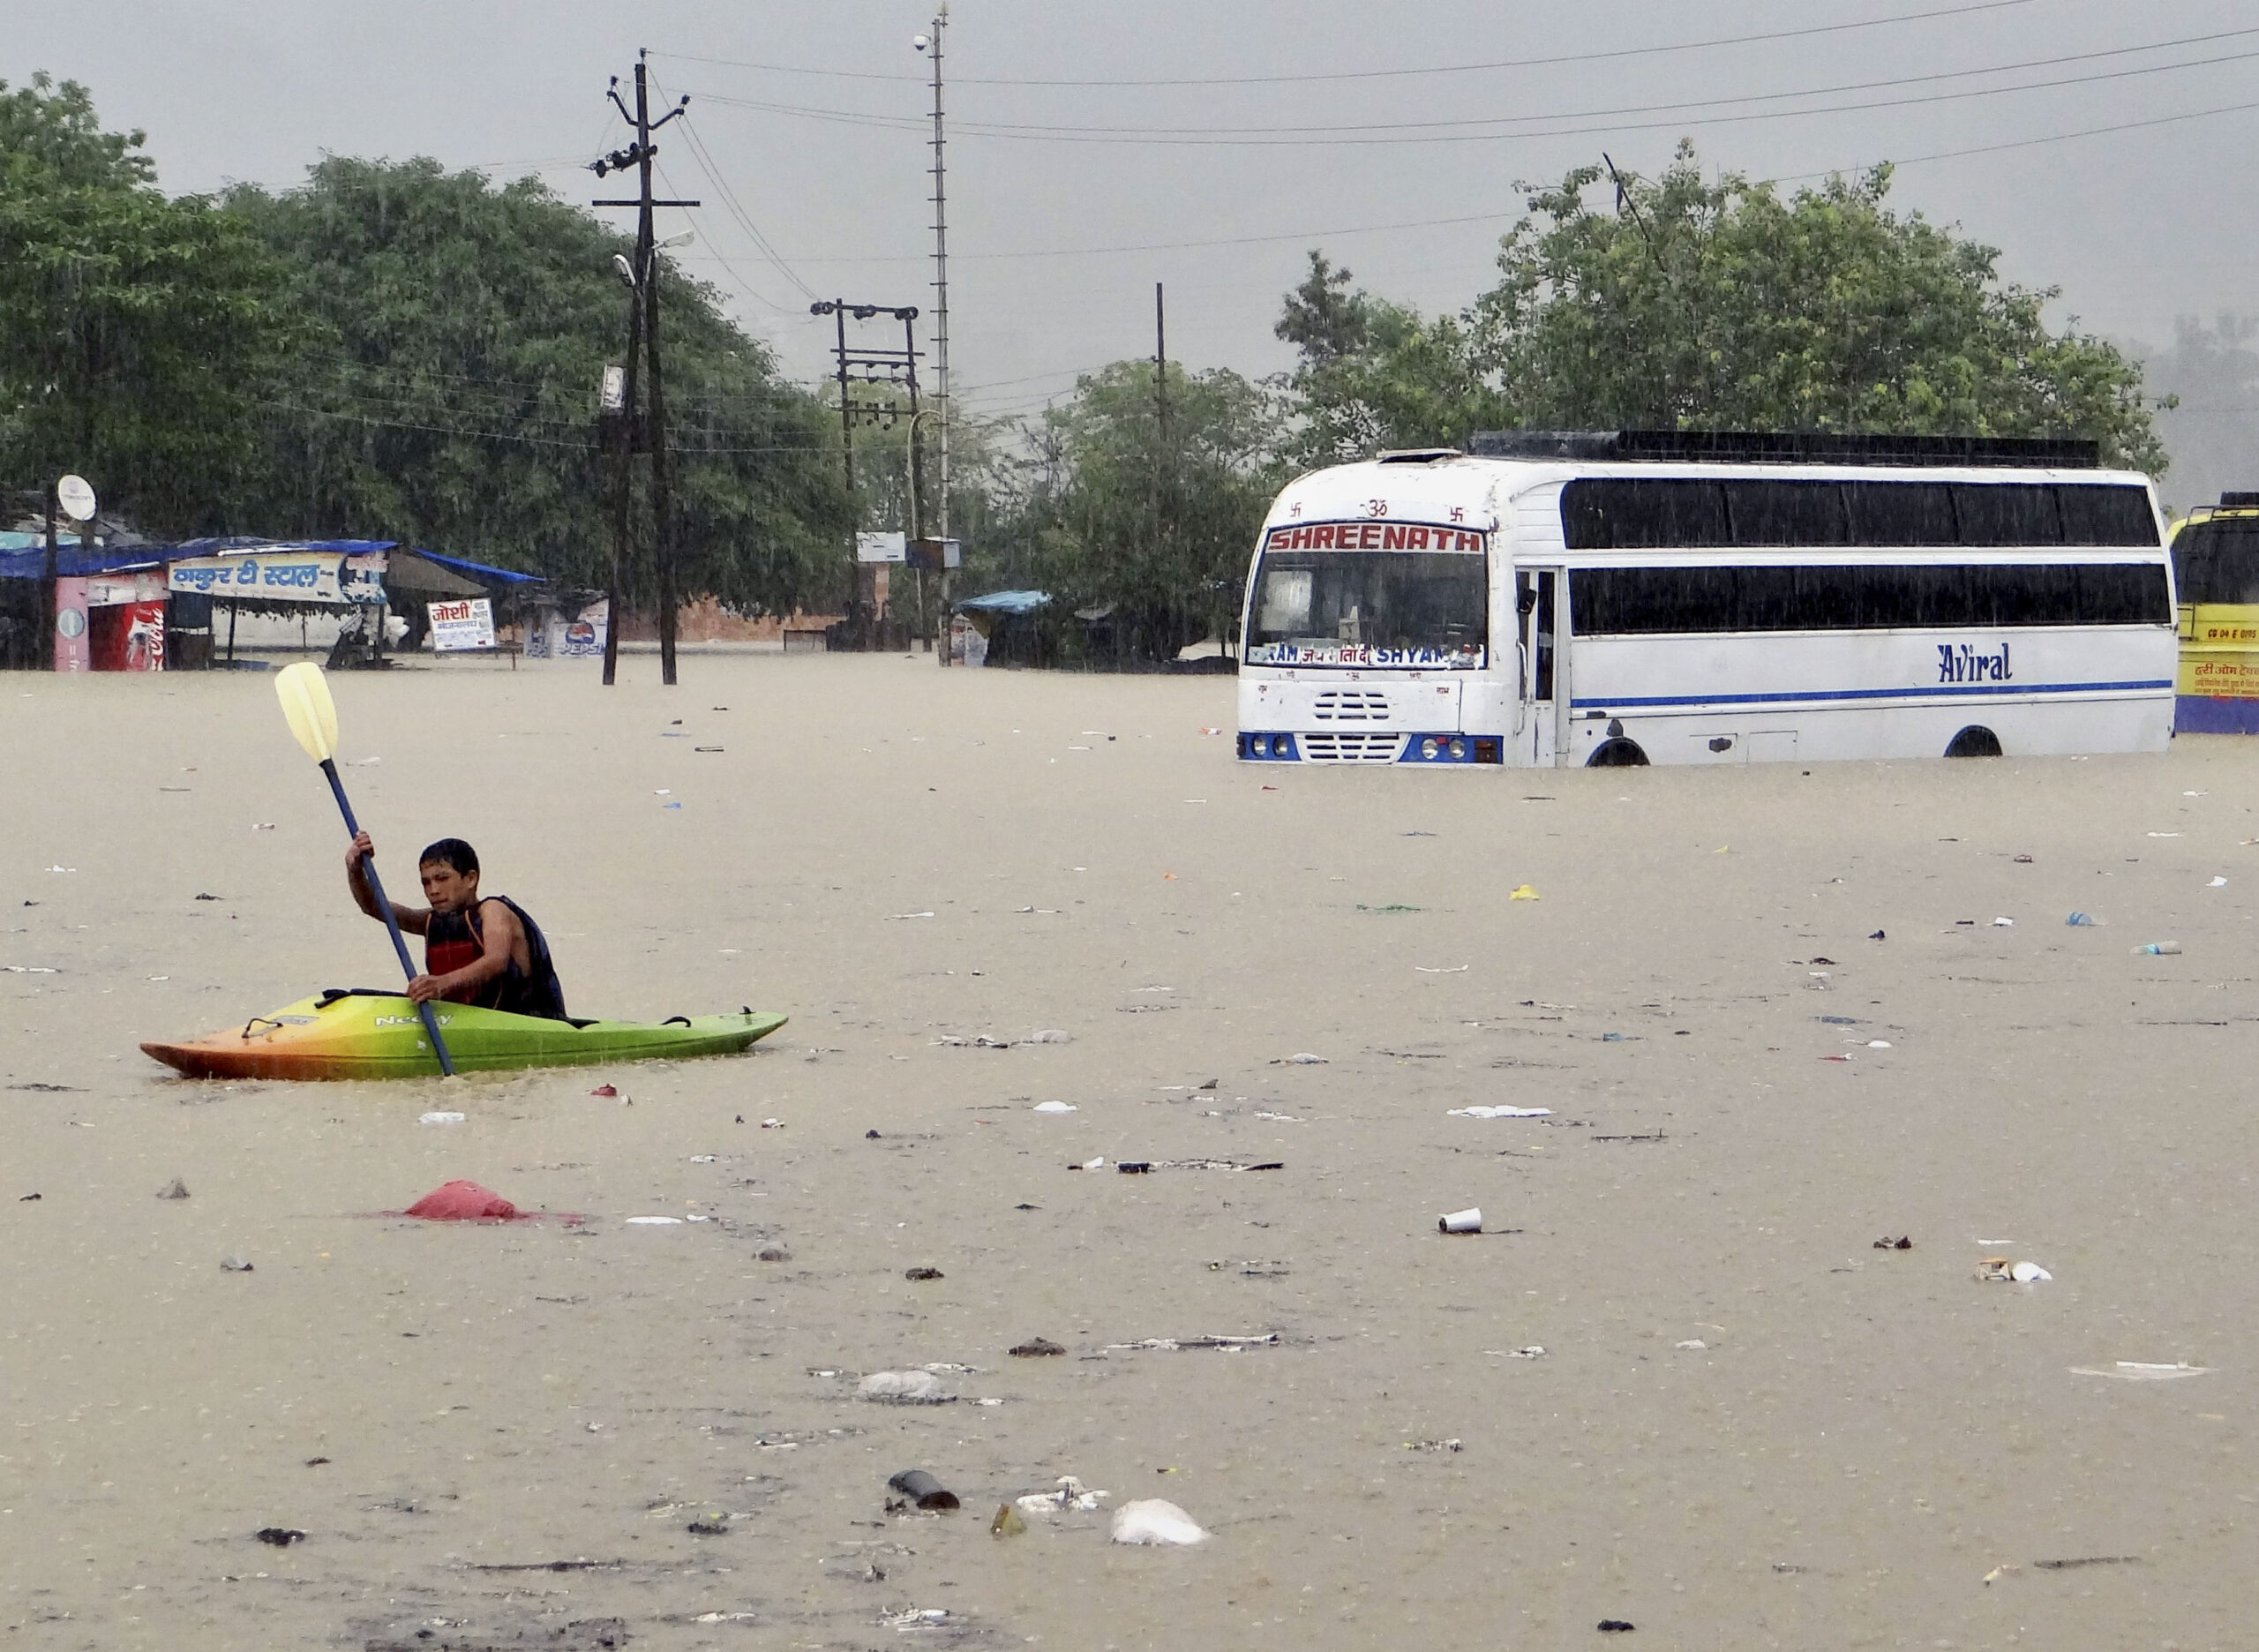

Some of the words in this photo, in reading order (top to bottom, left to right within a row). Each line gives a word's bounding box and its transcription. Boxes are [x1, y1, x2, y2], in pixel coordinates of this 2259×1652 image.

[1269, 524, 1481, 552] SHREENATH
[174, 567, 234, 590] ठाकुर
[236, 559, 259, 585] टी
[432, 602, 470, 621] जोशी
[2232, 629, 2238, 639] E
[1937, 642, 2013, 682] Aviral
[375, 1015, 453, 1026] Necy
